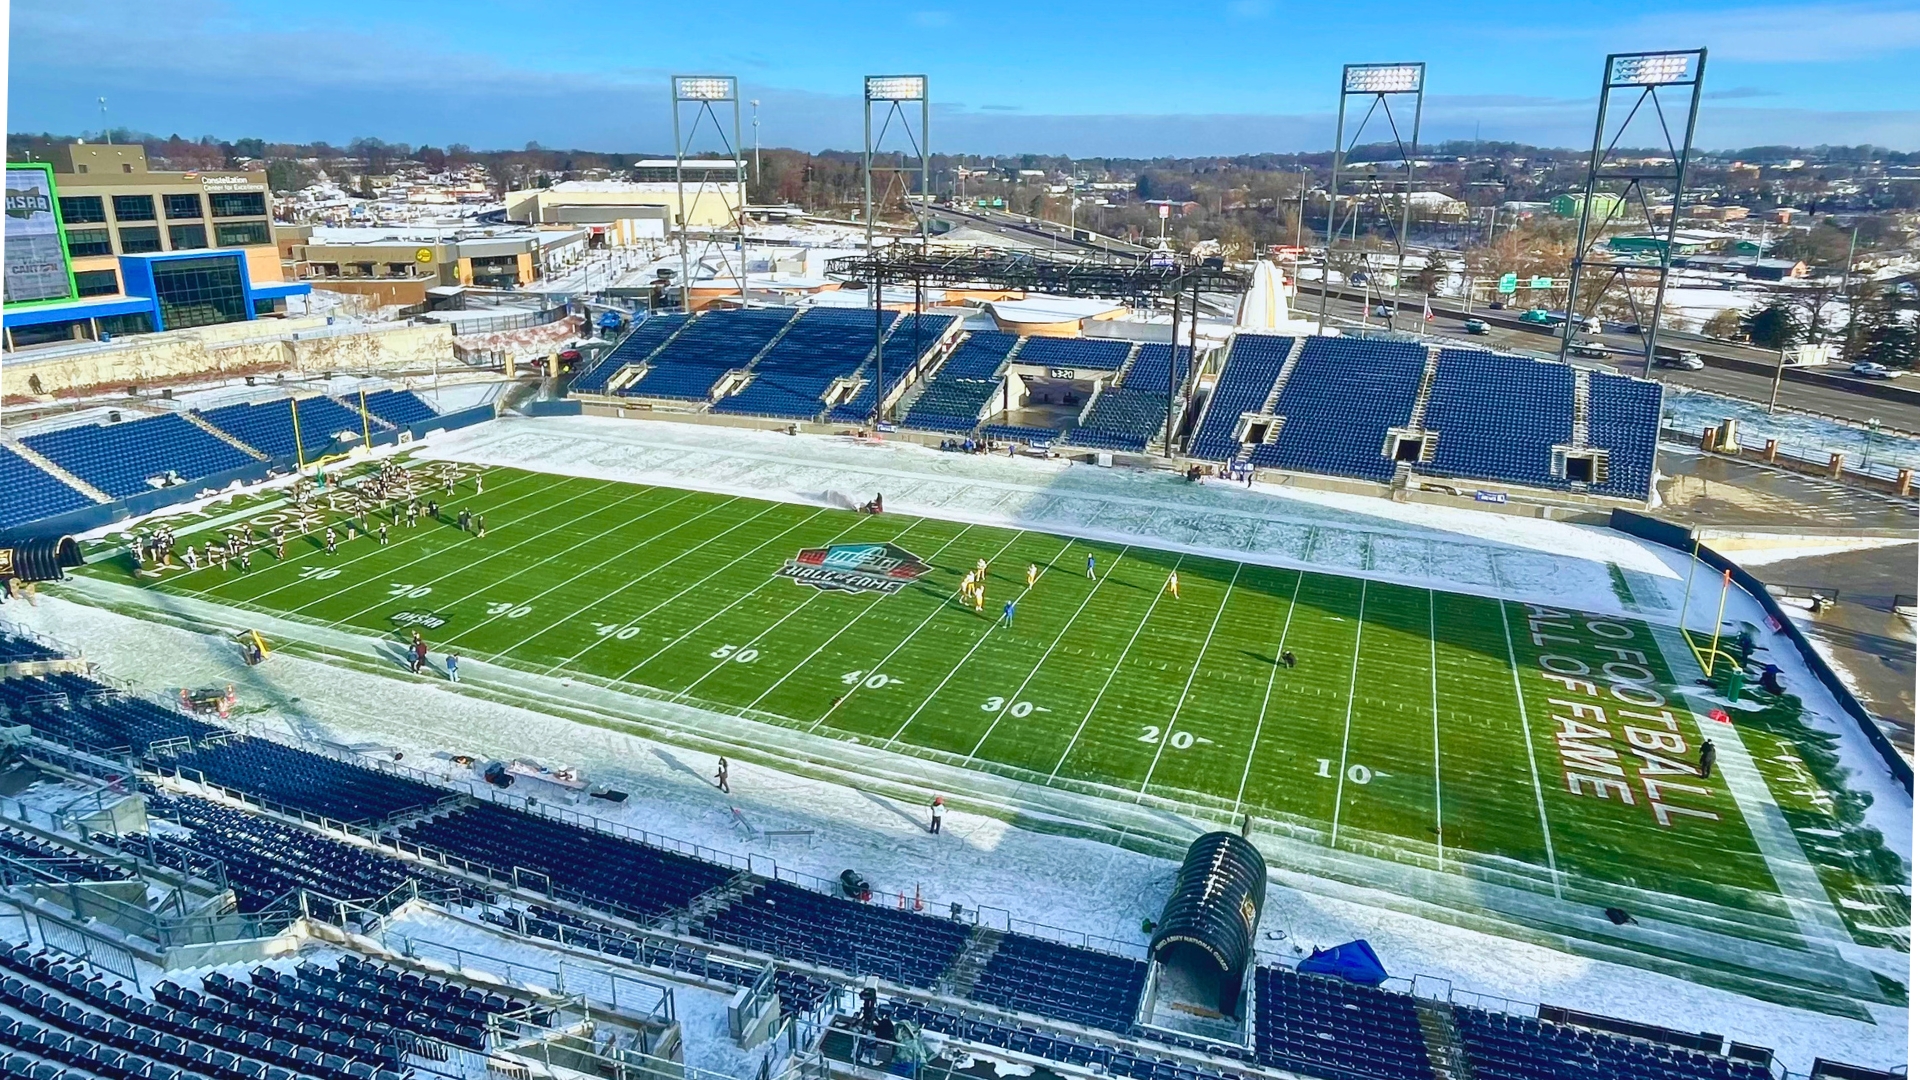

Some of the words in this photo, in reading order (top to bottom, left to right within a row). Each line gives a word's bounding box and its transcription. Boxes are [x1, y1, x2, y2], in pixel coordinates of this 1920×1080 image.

[201, 176, 248, 184] Constellation
[785, 565, 834, 581] HALL
[846, 575, 899, 591] FAME
[388, 584, 432, 598] 20
[487, 602, 532, 618] 30
[596, 623, 640, 640] 40
[710, 644, 759, 663] 50
[841, 670, 888, 689] 40
[1538, 654, 1598, 697] OF
[980, 696, 1032, 718] 30
[1138, 726, 1194, 750] 20
[1594, 644, 1720, 827] FOOTBALL
[1547, 698, 1635, 805] FAME
[1314, 759, 1372, 785] 10
[1183, 936, 1214, 953] NATIONAL
